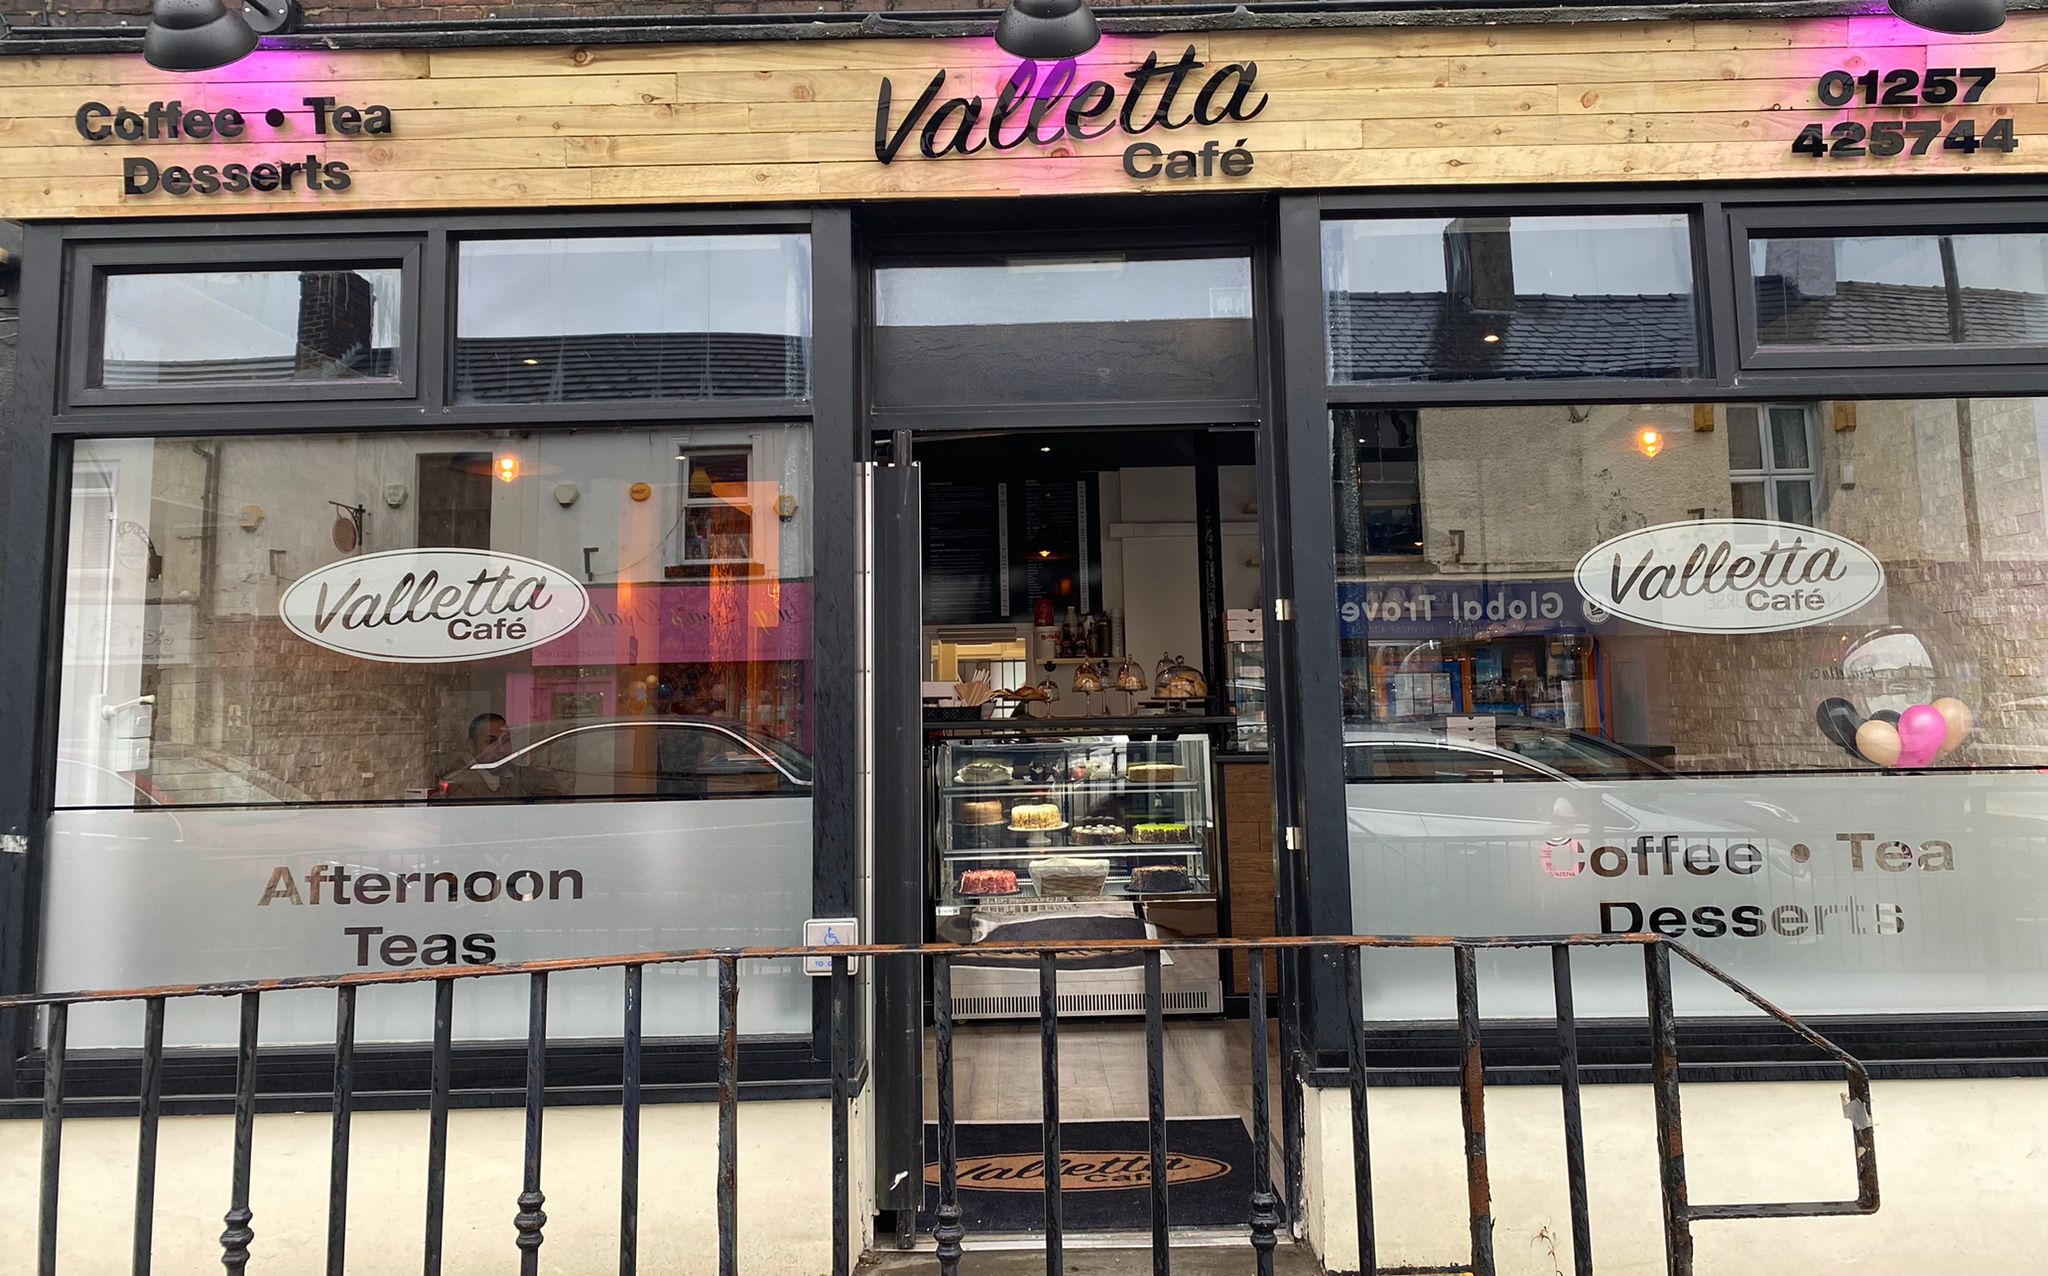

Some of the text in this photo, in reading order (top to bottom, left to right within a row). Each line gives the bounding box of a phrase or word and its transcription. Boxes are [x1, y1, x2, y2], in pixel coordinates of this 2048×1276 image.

[875, 44, 1269, 165] Valletta
[1818, 67, 1997, 106] 01257
[75, 96, 392, 141] Coffee Tea
[1791, 118, 2019, 157] 425744
[123, 154, 352, 195] Desserts
[1123, 138, 1254, 180] Café
[1611, 536, 1847, 604] Valletta
[314, 565, 553, 634] Valletta
[1746, 588, 1825, 612] Café
[447, 616, 527, 641] Café
[1540, 832, 1955, 879] Coffee Tea
[257, 865, 584, 906] Afternoon
[1600, 896, 1906, 939] Desserts
[344, 926, 497, 966] Teas
